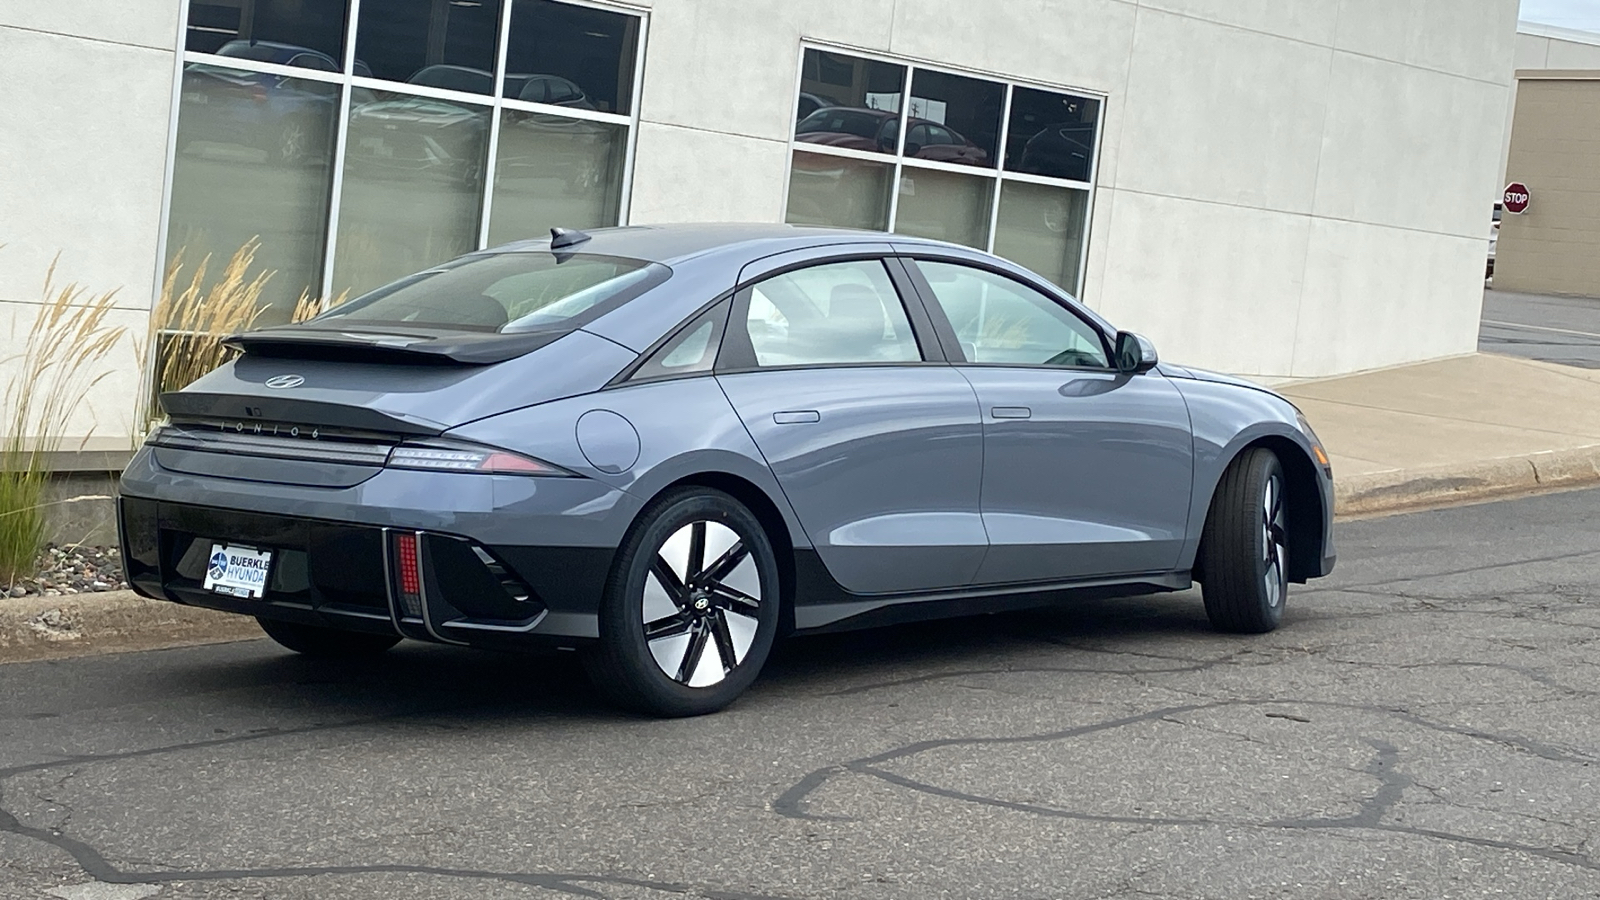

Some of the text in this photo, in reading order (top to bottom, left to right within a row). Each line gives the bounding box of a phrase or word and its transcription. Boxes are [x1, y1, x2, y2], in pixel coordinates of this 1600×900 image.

[1504, 192, 1528, 204] STOP
[230, 556, 269, 570] BUERKLE
[227, 566, 264, 583] HYUNDA
